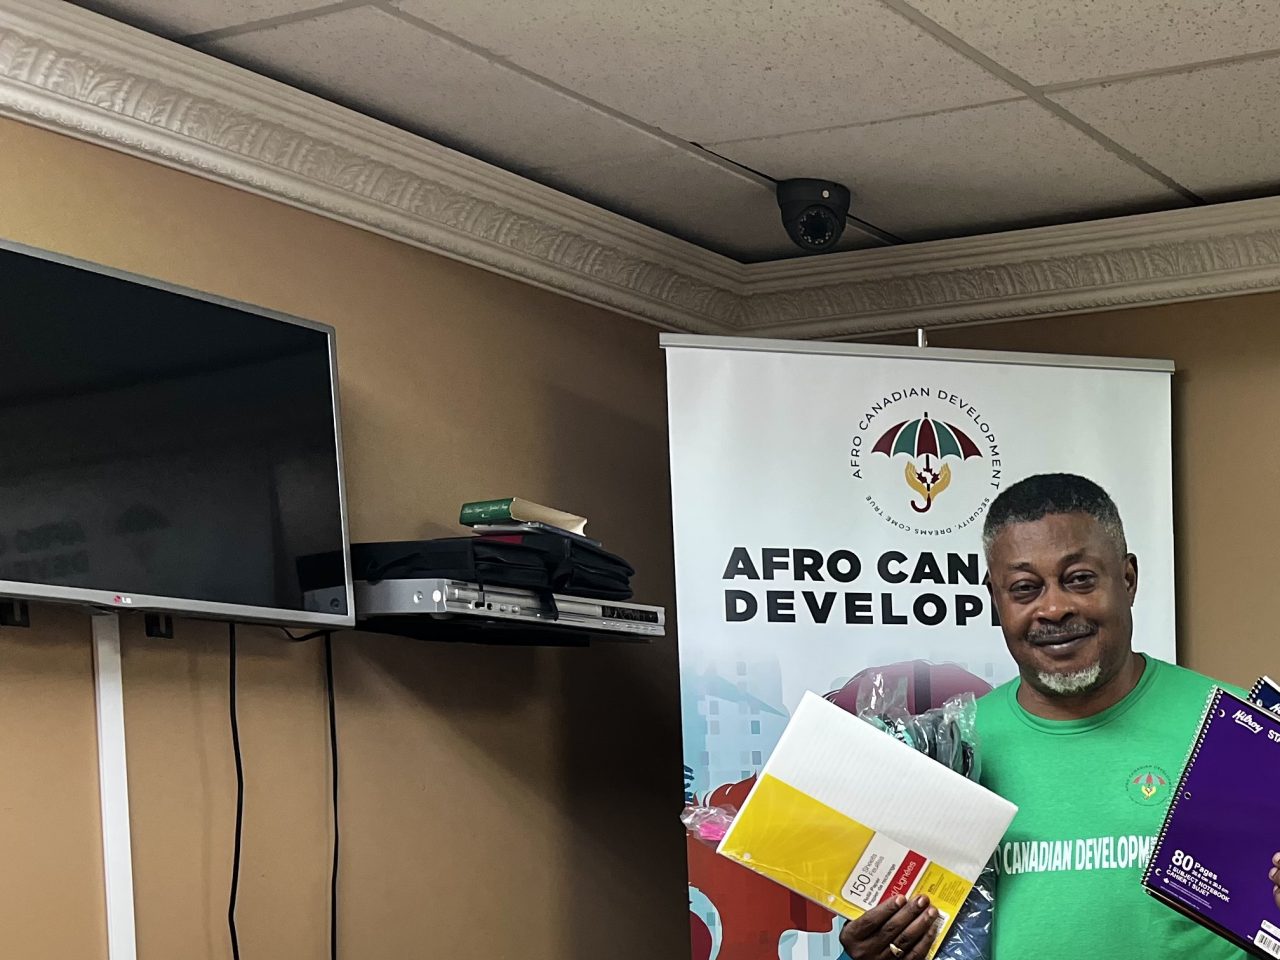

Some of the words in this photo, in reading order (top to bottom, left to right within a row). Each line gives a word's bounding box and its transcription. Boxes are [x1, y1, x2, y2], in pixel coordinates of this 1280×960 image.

[850, 435, 863, 479] AFRO
[859, 387, 930, 431] CANADIAN
[938, 390, 1002, 490] DEVELOPMENT
[866, 495, 884, 516] TRUE
[886, 516, 911, 532] COME
[914, 527, 952, 536] DREAMS
[722, 547, 862, 584] AFRO
[876, 549, 990, 585] CAN
[1232, 709, 1263, 734] Hilroy
[1003, 840, 1072, 875] CANADIAN
[1171, 849, 1194, 871] 80
[1193, 862, 1218, 881] Pages
[849, 873, 871, 897] 150
[1166, 869, 1188, 885] CAHIER
[1191, 884, 1210, 897] SUJET
[1172, 866, 1199, 884] SUBJECT
[1198, 881, 1231, 903] NOTEBOOK
